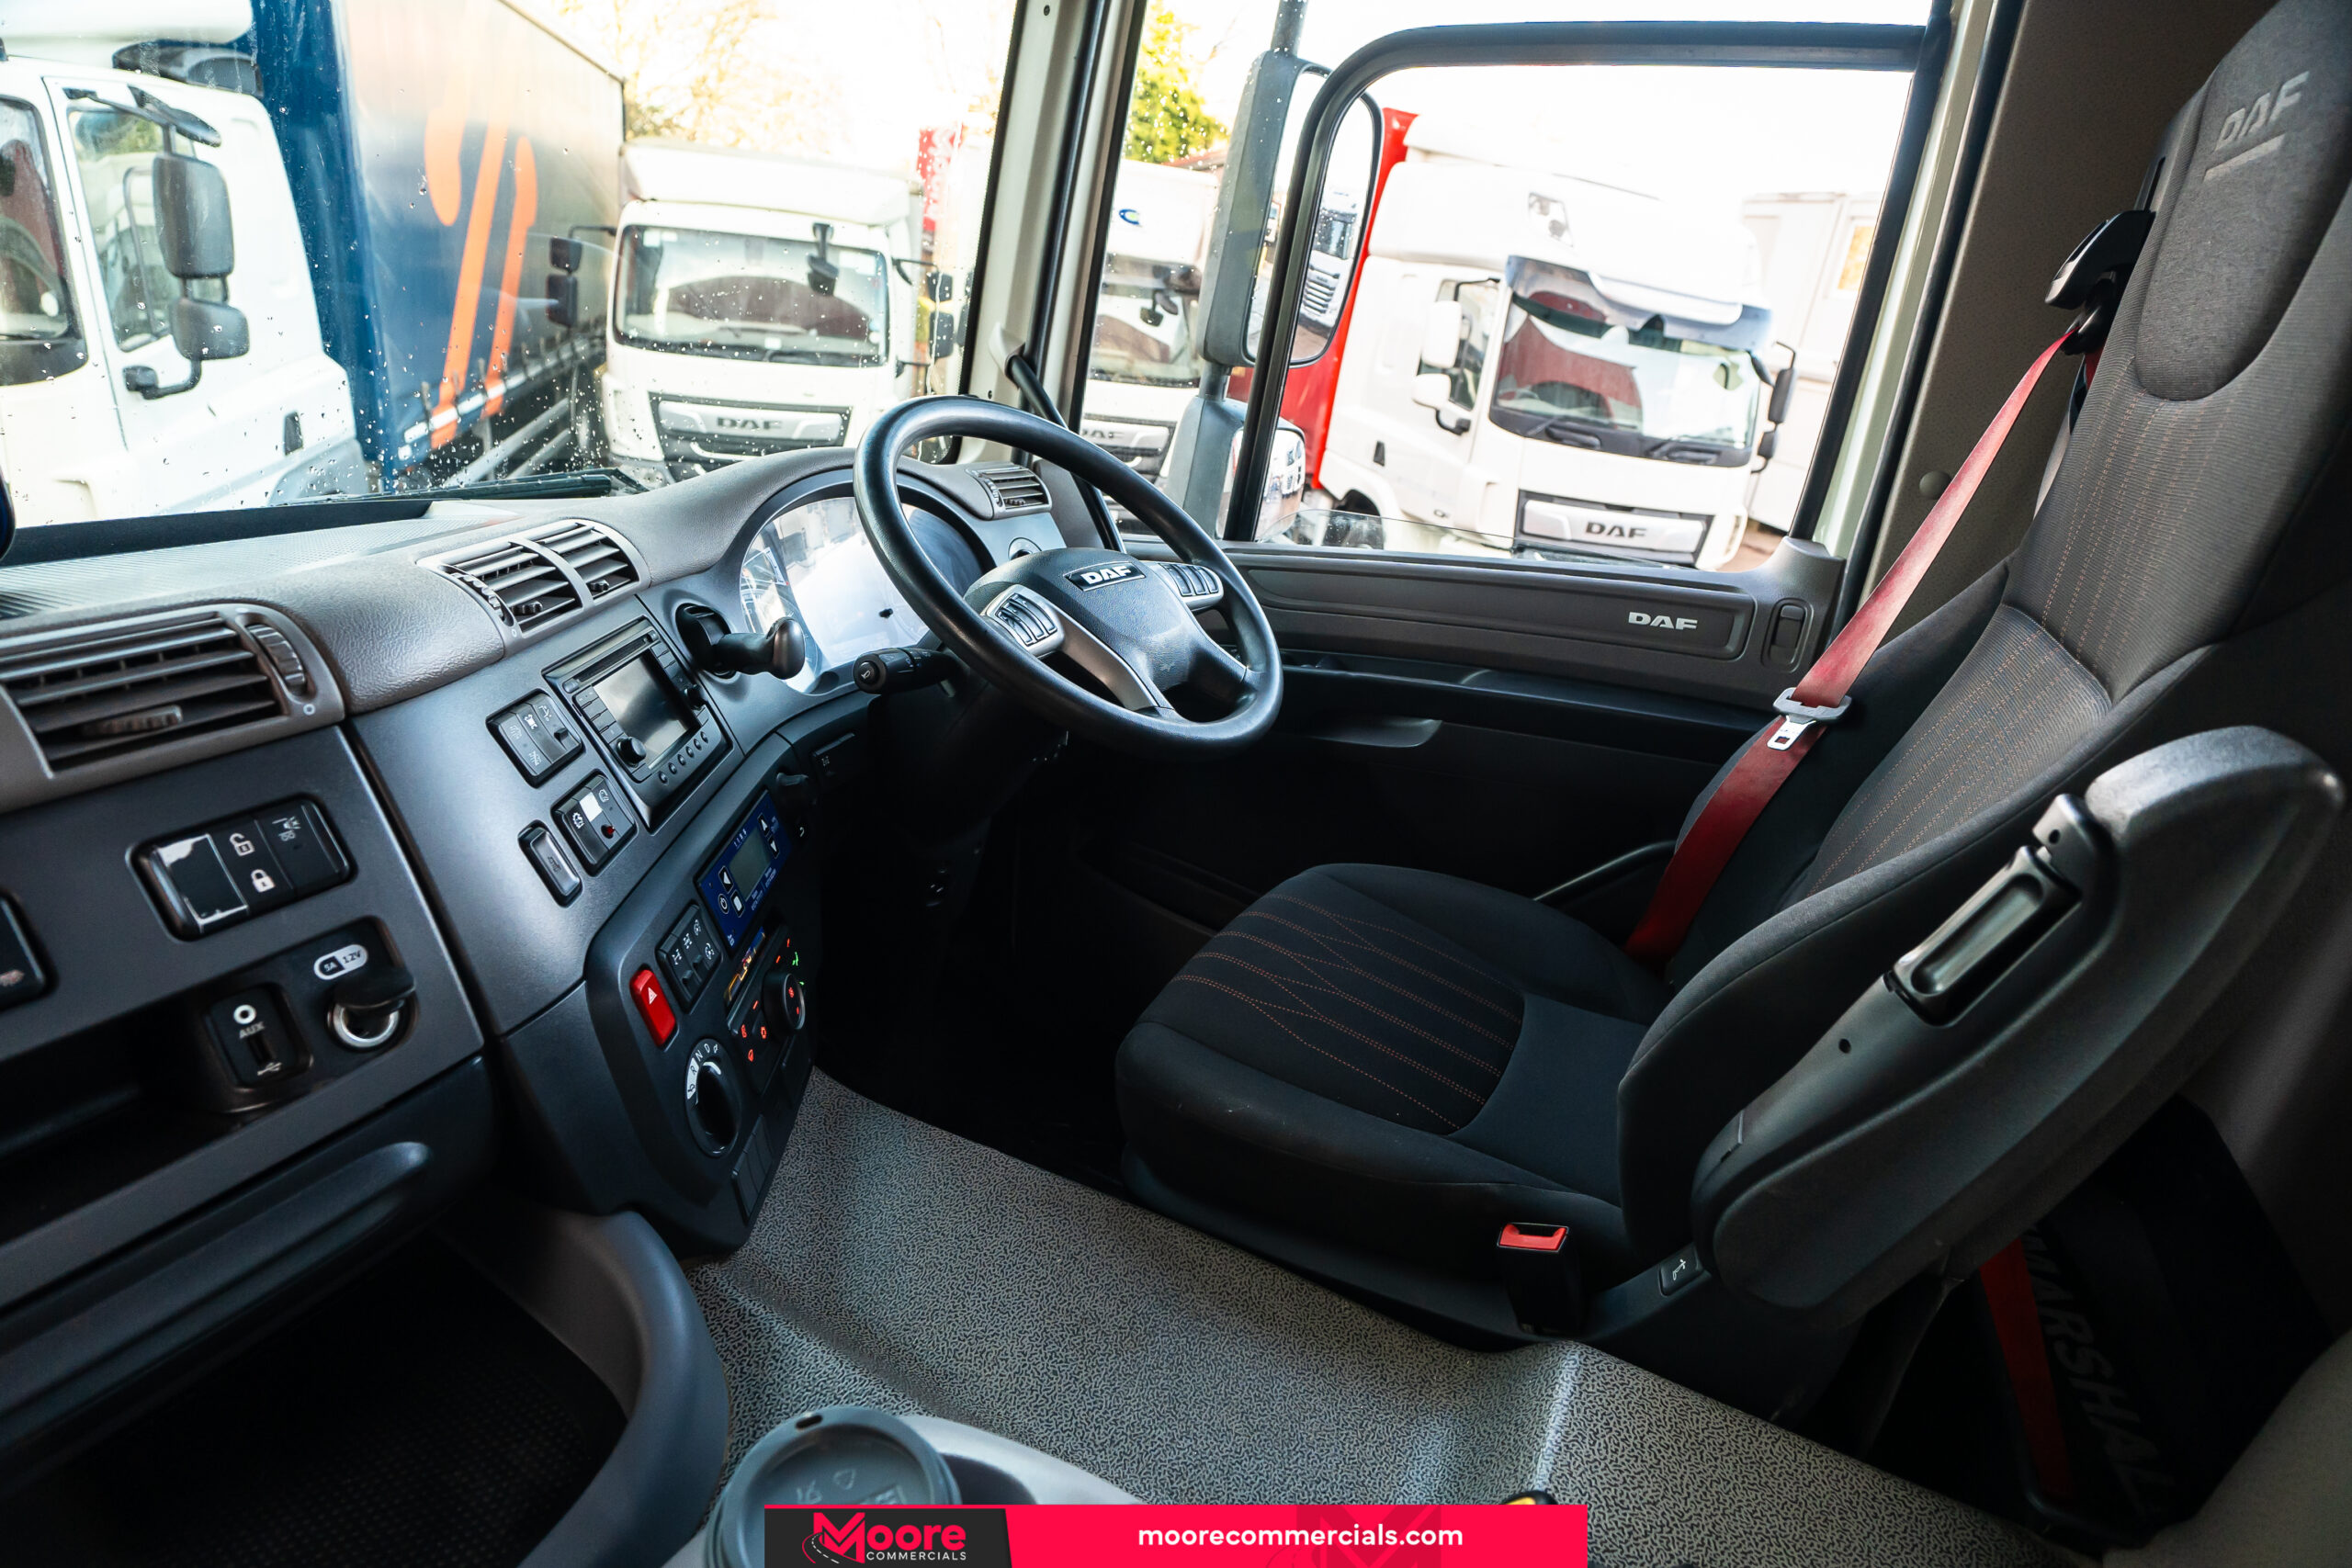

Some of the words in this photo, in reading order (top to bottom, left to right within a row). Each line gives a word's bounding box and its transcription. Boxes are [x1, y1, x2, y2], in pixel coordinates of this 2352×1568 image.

[2214, 71, 2310, 152] DAF
[717, 417, 782, 430] DAF
[1585, 522, 1647, 538] DAF
[1080, 566, 1132, 585] DAF
[1628, 611, 1698, 630] DAF
[342, 950, 361, 964] 12V
[239, 1021, 266, 1039] AUX
